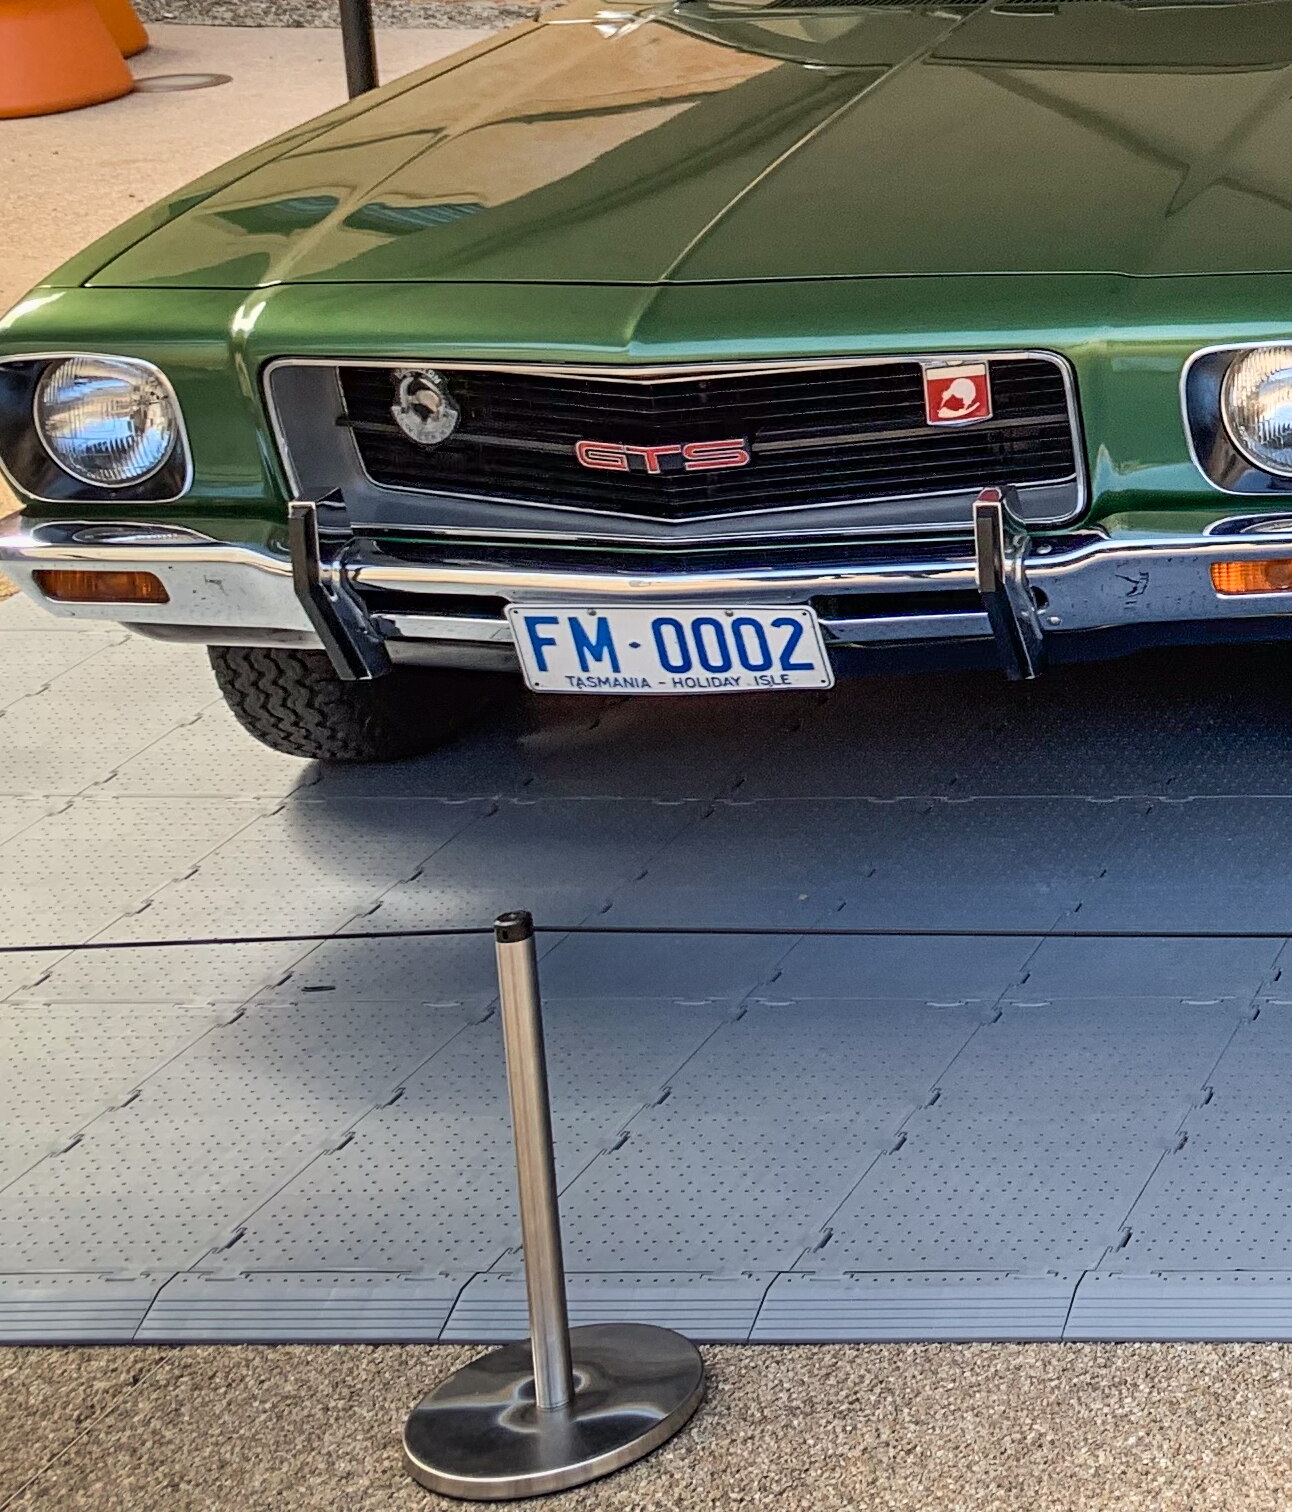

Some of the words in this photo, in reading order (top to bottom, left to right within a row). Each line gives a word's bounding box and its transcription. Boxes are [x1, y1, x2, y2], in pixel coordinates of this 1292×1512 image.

[575, 439, 751, 474] GTS
[565, 675, 650, 689] TASMANIA
[673, 675, 741, 687] HOLIDAY
[753, 674, 793, 687] ISLE
